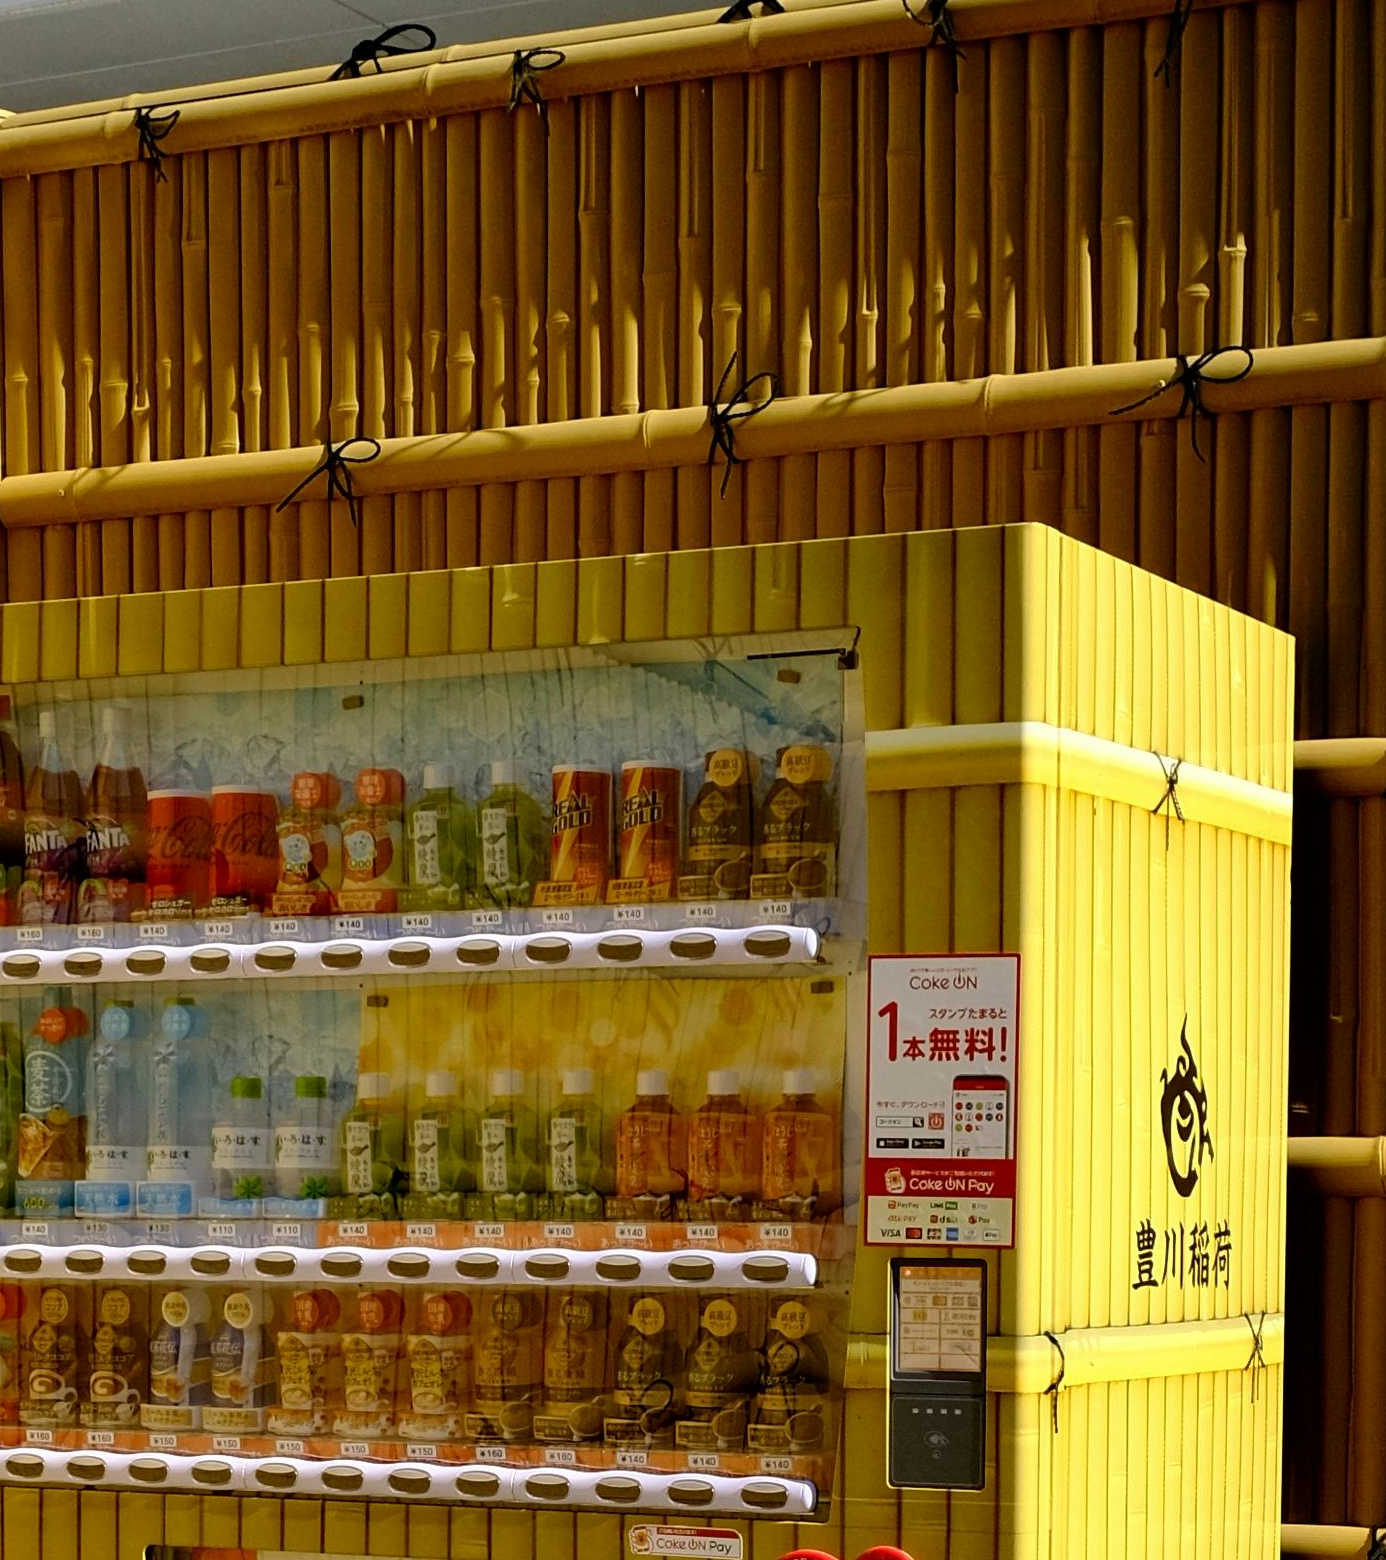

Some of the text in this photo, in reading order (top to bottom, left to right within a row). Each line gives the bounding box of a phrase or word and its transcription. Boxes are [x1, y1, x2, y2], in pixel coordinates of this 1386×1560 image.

[87, 827, 130, 852] FANTA
[909, 976, 949, 990] Coke
[929, 1008, 1007, 1020] スタンプたまると
[30, 1056, 51, 1106] 麦茶
[909, 1178, 943, 1190] Coke
[968, 1179, 994, 1194] Pay
[881, 1228, 901, 1238] VISA
[1132, 1218, 1232, 1290] 豊川稲荷
[656, 1537, 685, 1550] Coke
[709, 1540, 733, 1554] Pay
